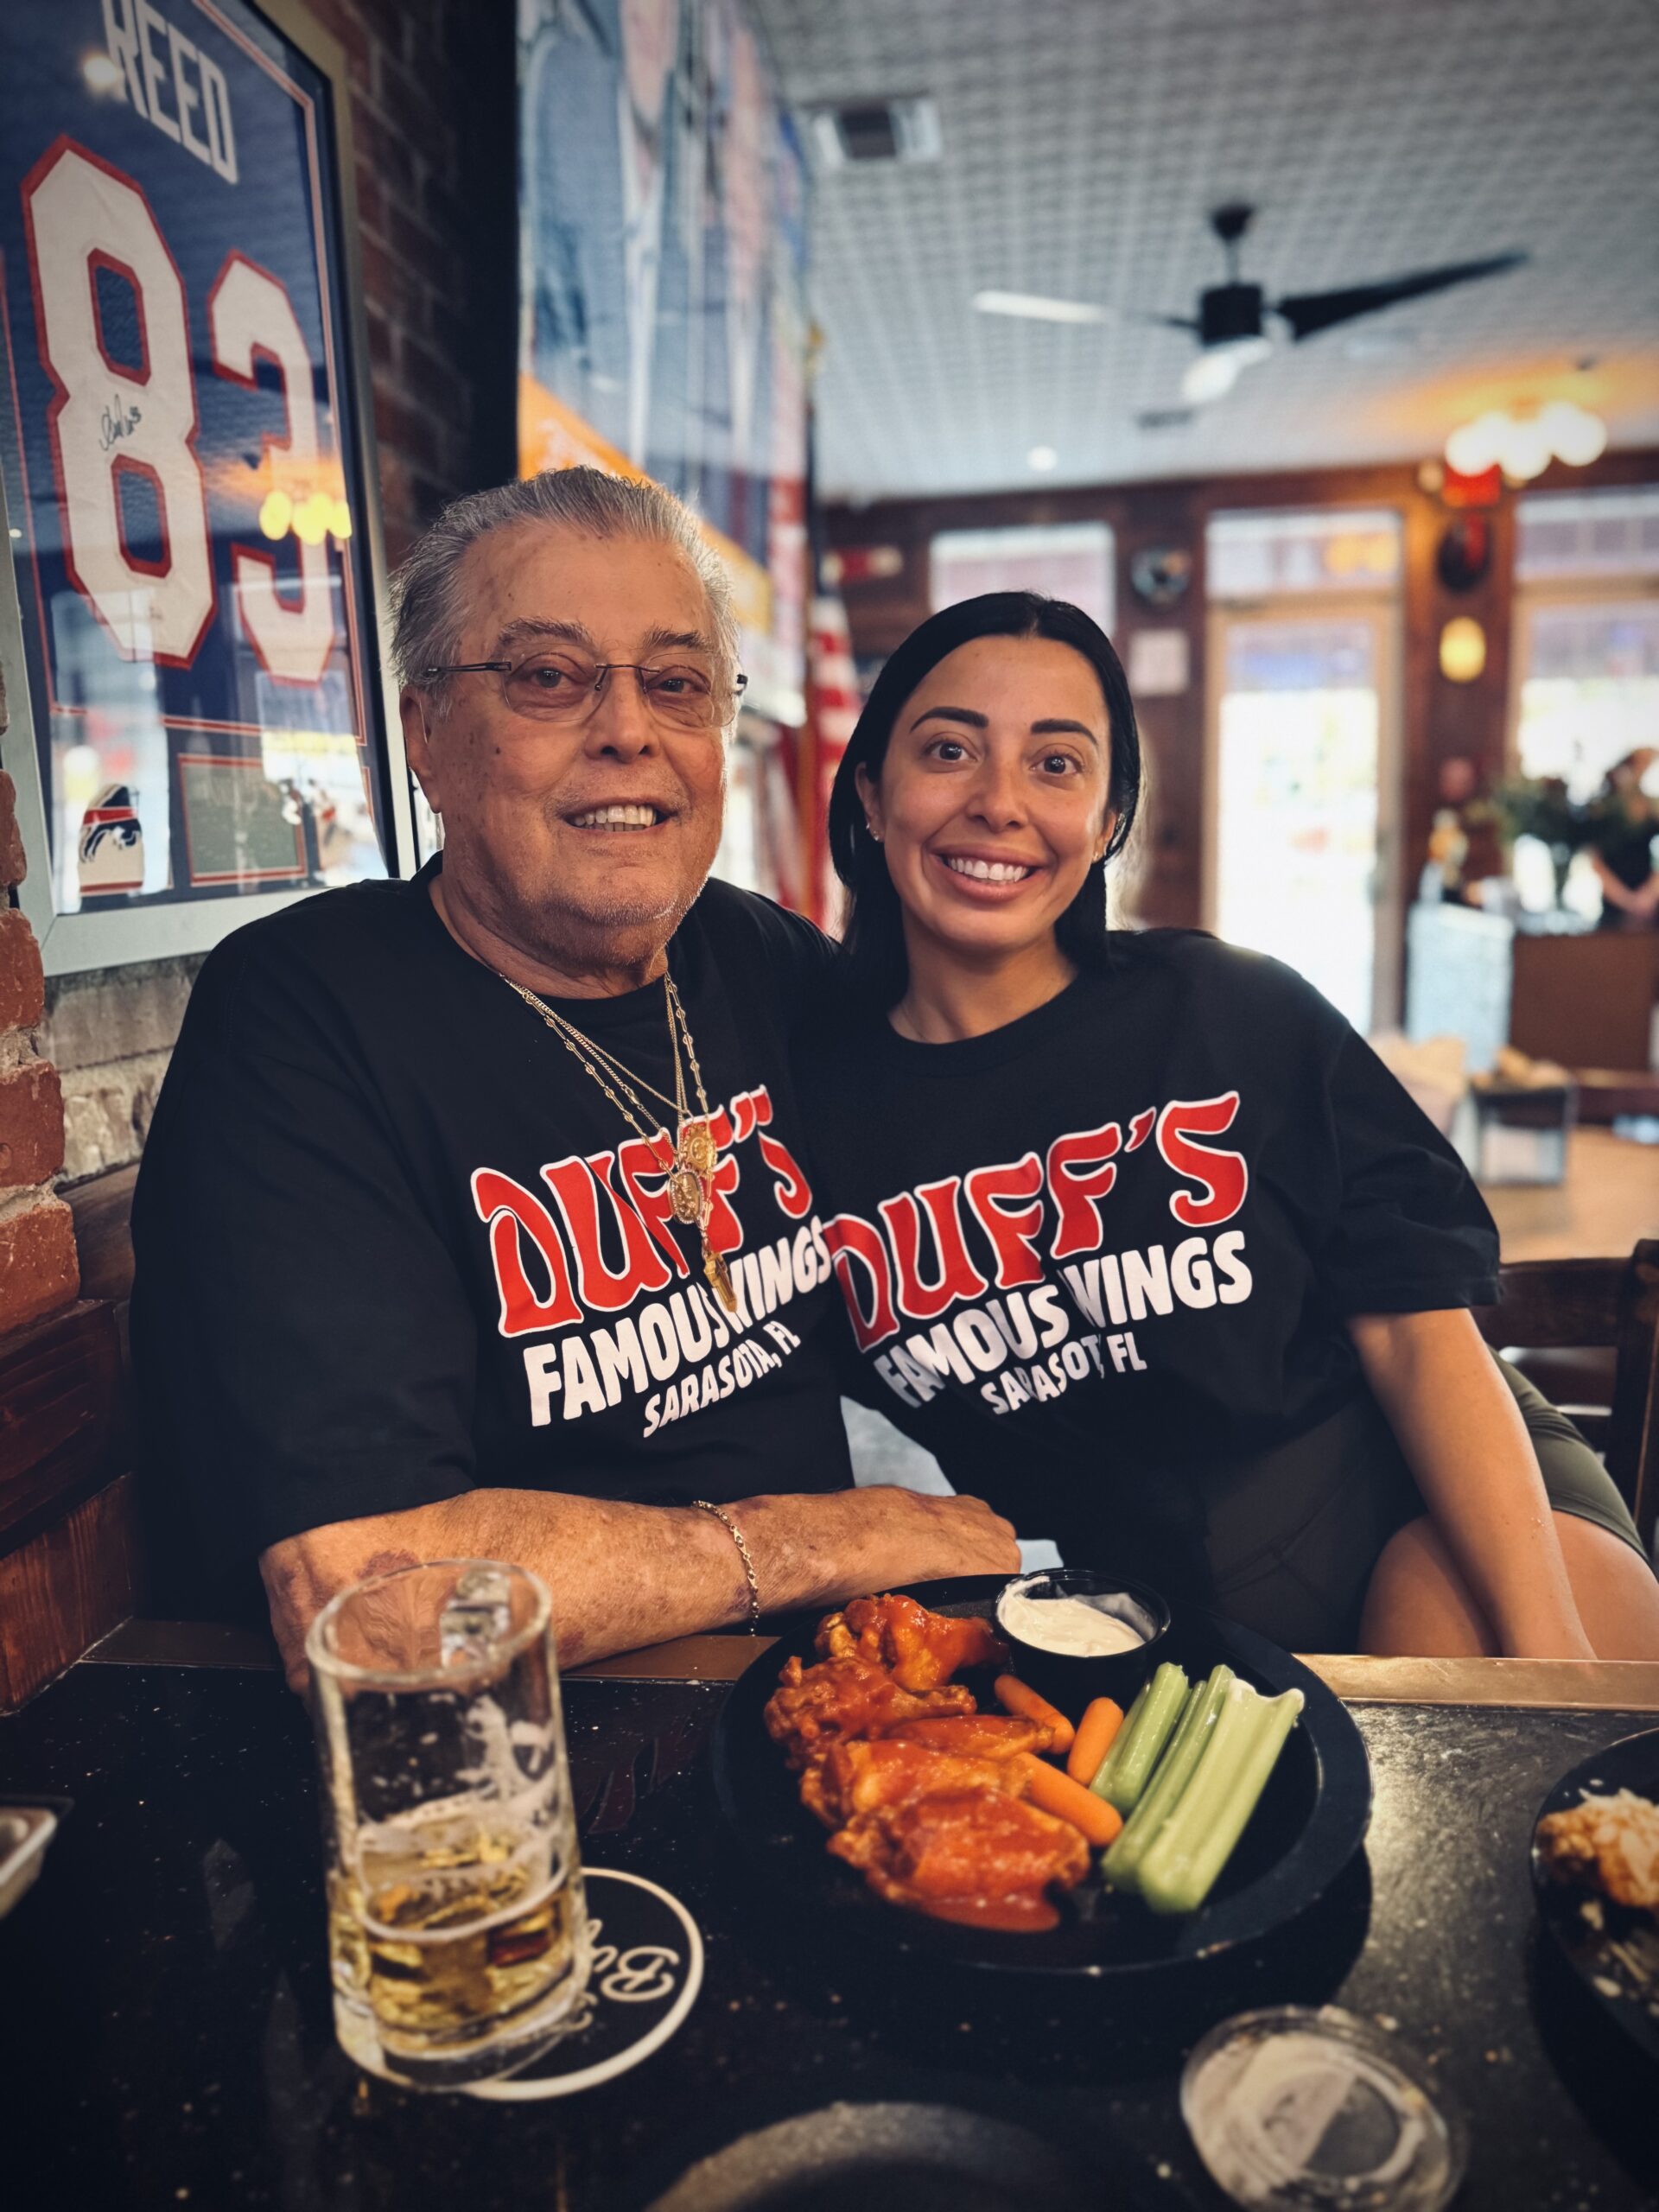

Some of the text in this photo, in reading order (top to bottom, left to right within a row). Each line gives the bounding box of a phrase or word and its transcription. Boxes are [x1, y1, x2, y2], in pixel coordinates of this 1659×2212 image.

[101, 0, 239, 185] REED
[20, 134, 338, 688] 83
[822, 1090, 1249, 1353] DUFF'S
[763, 1320, 801, 1356] FL
[873, 1285, 1070, 1408] FAMOUS
[1107, 1332, 1148, 1373] FL
